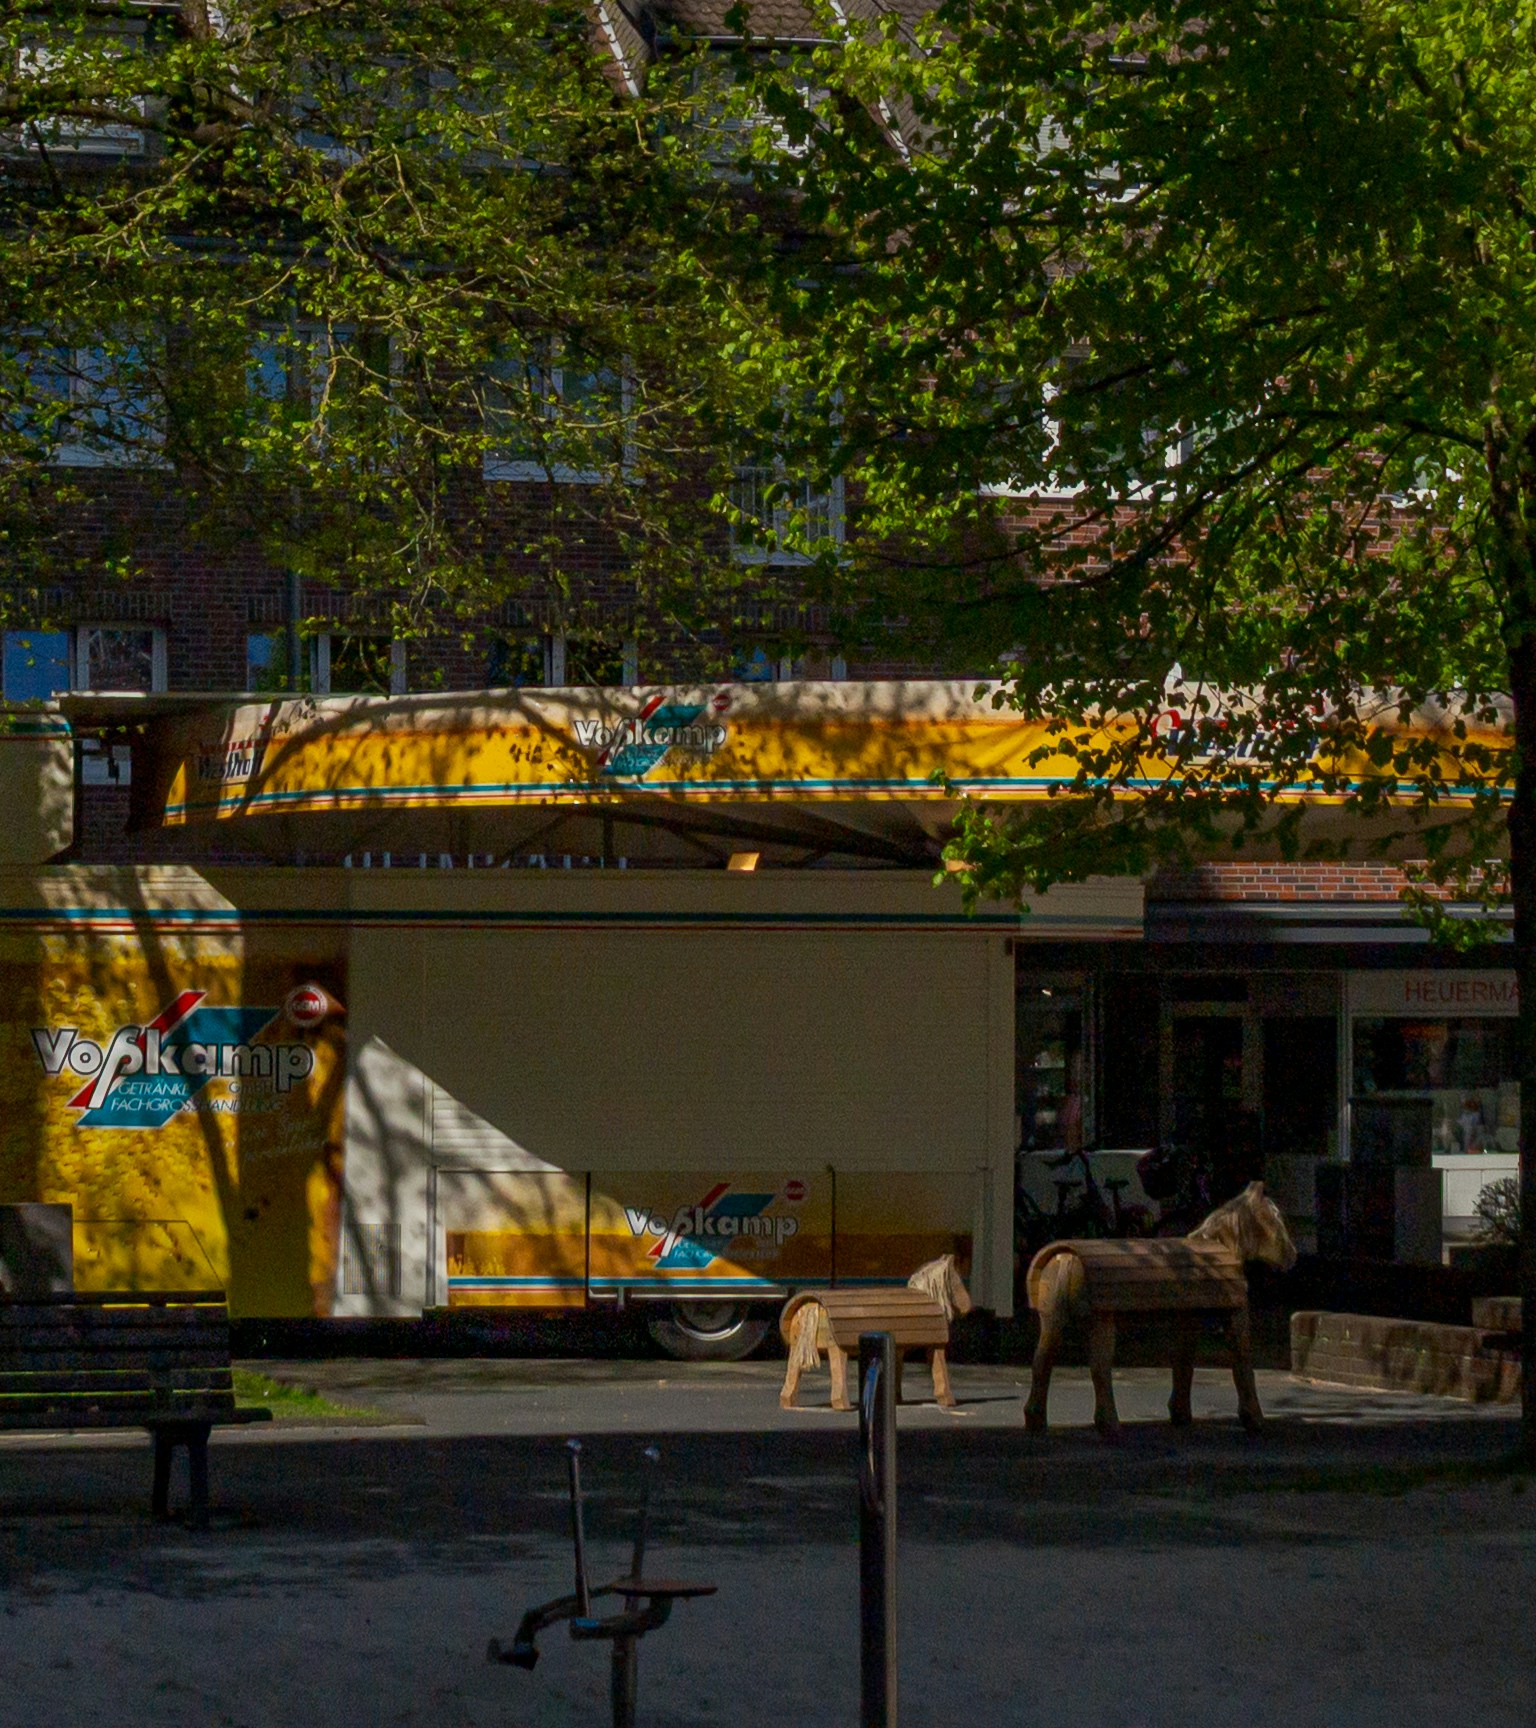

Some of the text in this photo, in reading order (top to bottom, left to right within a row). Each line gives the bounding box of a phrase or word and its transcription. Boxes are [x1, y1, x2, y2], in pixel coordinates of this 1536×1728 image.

[573, 717, 726, 766] Voßkamp
[31, 1025, 313, 1110] Voßkamp
[117, 1078, 188, 1096] GETRÄNKE
[624, 1205, 798, 1257] Voßkamp
